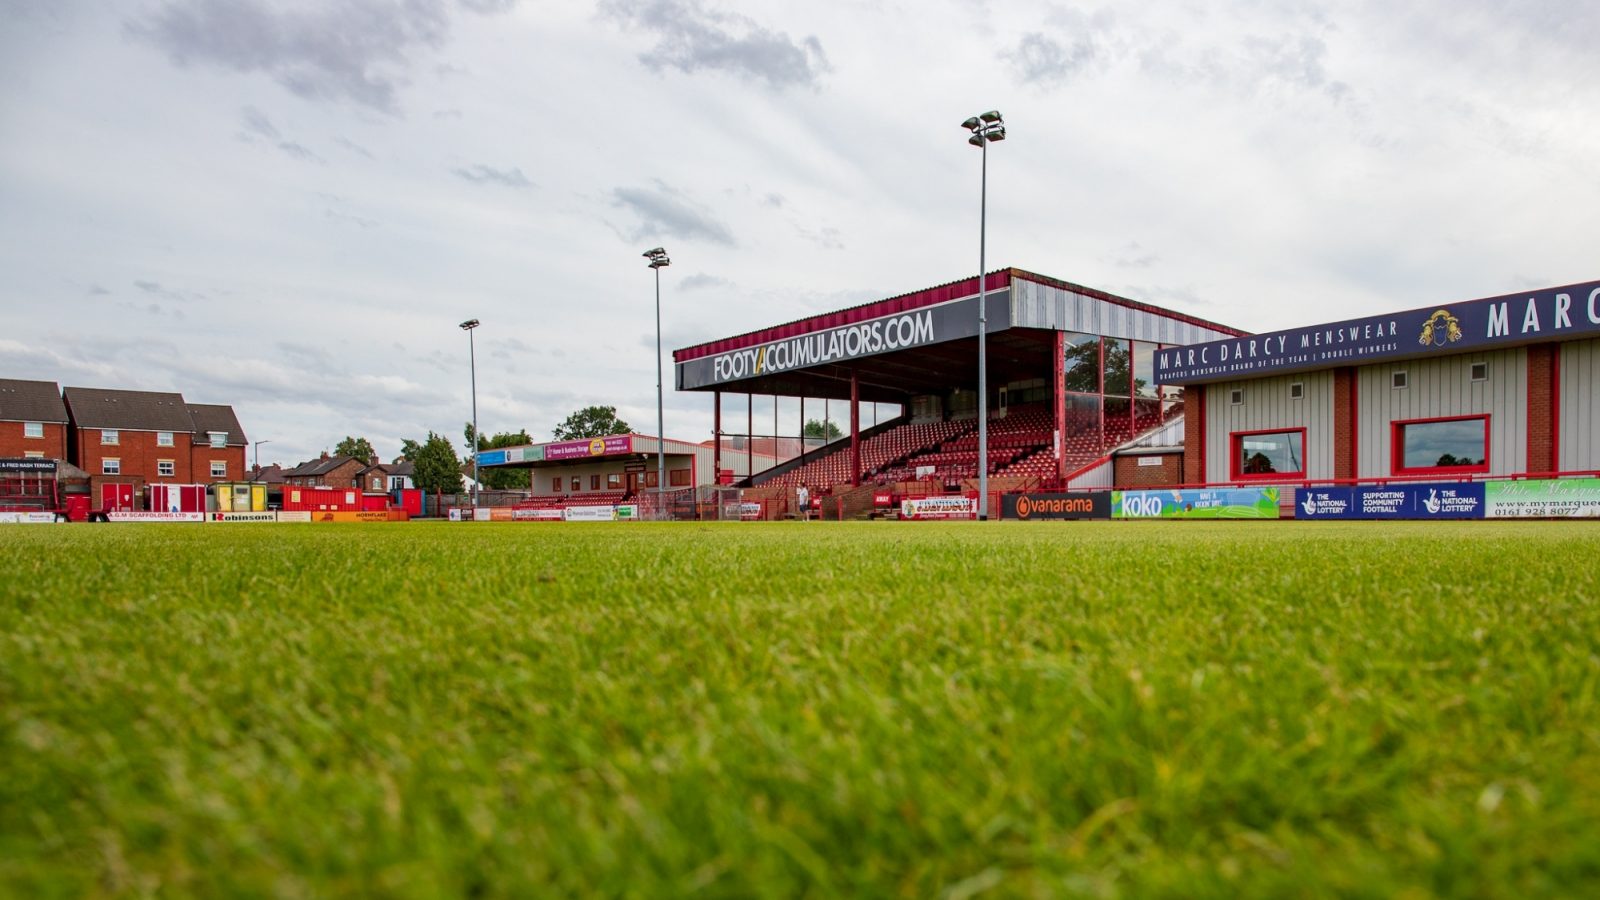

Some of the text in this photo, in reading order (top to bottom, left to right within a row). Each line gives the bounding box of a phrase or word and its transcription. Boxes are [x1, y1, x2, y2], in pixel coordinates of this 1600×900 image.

[1486, 287, 1600, 338] MARC
[714, 309, 934, 382] FOOTYACCUMULATORS.COM
[1159, 321, 1397, 370] MARC DARCY MENSWEAR
[1192, 365, 1227, 376] MENSWEAR
[1231, 361, 1254, 371] BRAND
[1258, 359, 1267, 368] OF
[1271, 357, 1285, 366] THE
[1289, 354, 1308, 364] YEAR
[1321, 348, 1353, 359] DOUBLE
[1358, 342, 1398, 355] WINNERS
[212, 513, 274, 521] Robinsons
[1031, 499, 1093, 512] vanarama
[1442, 497, 1478, 505] NATIONAL
